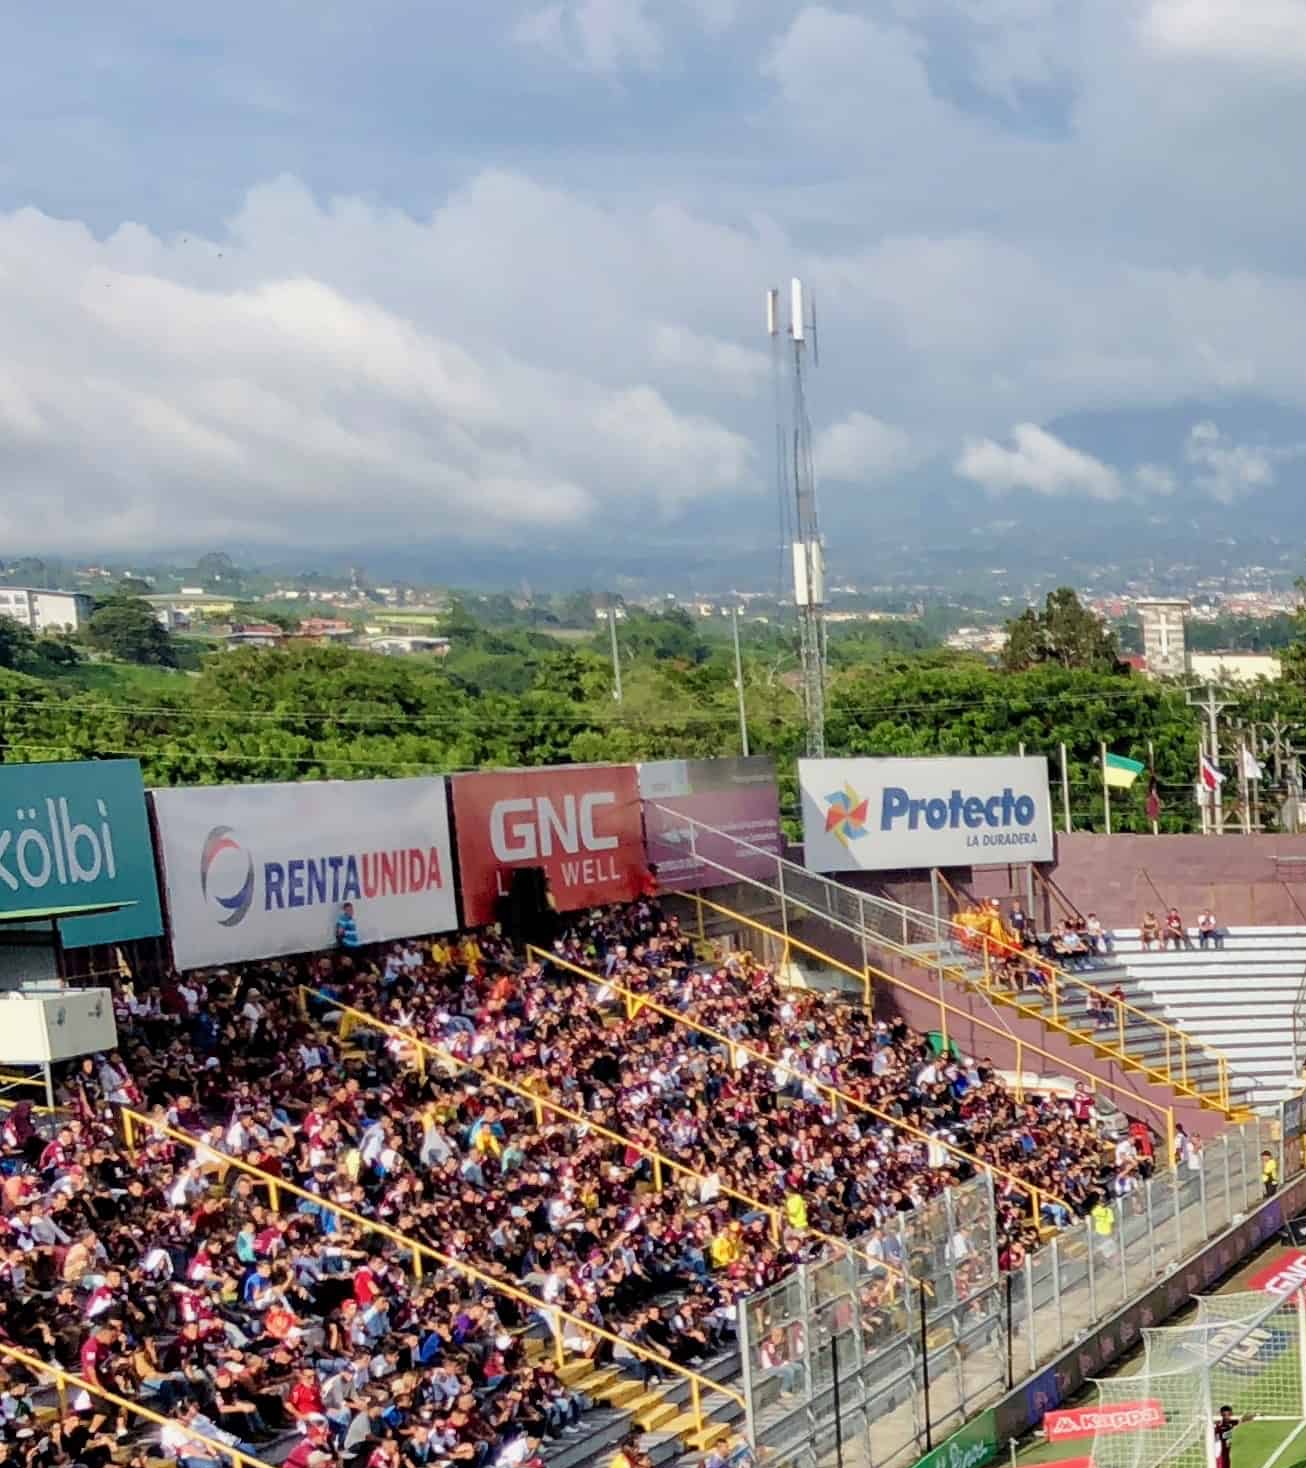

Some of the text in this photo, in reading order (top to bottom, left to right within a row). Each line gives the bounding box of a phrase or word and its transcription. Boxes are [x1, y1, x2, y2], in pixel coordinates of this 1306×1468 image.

[490, 791, 619, 863] GNC
[880, 786, 1035, 831] Protecto
[966, 832, 1038, 847] LA DURADERA
[264, 846, 443, 911] RENTAUNIDA
[561, 856, 621, 887] WELL
[1082, 1405, 1159, 1430] Kappa
